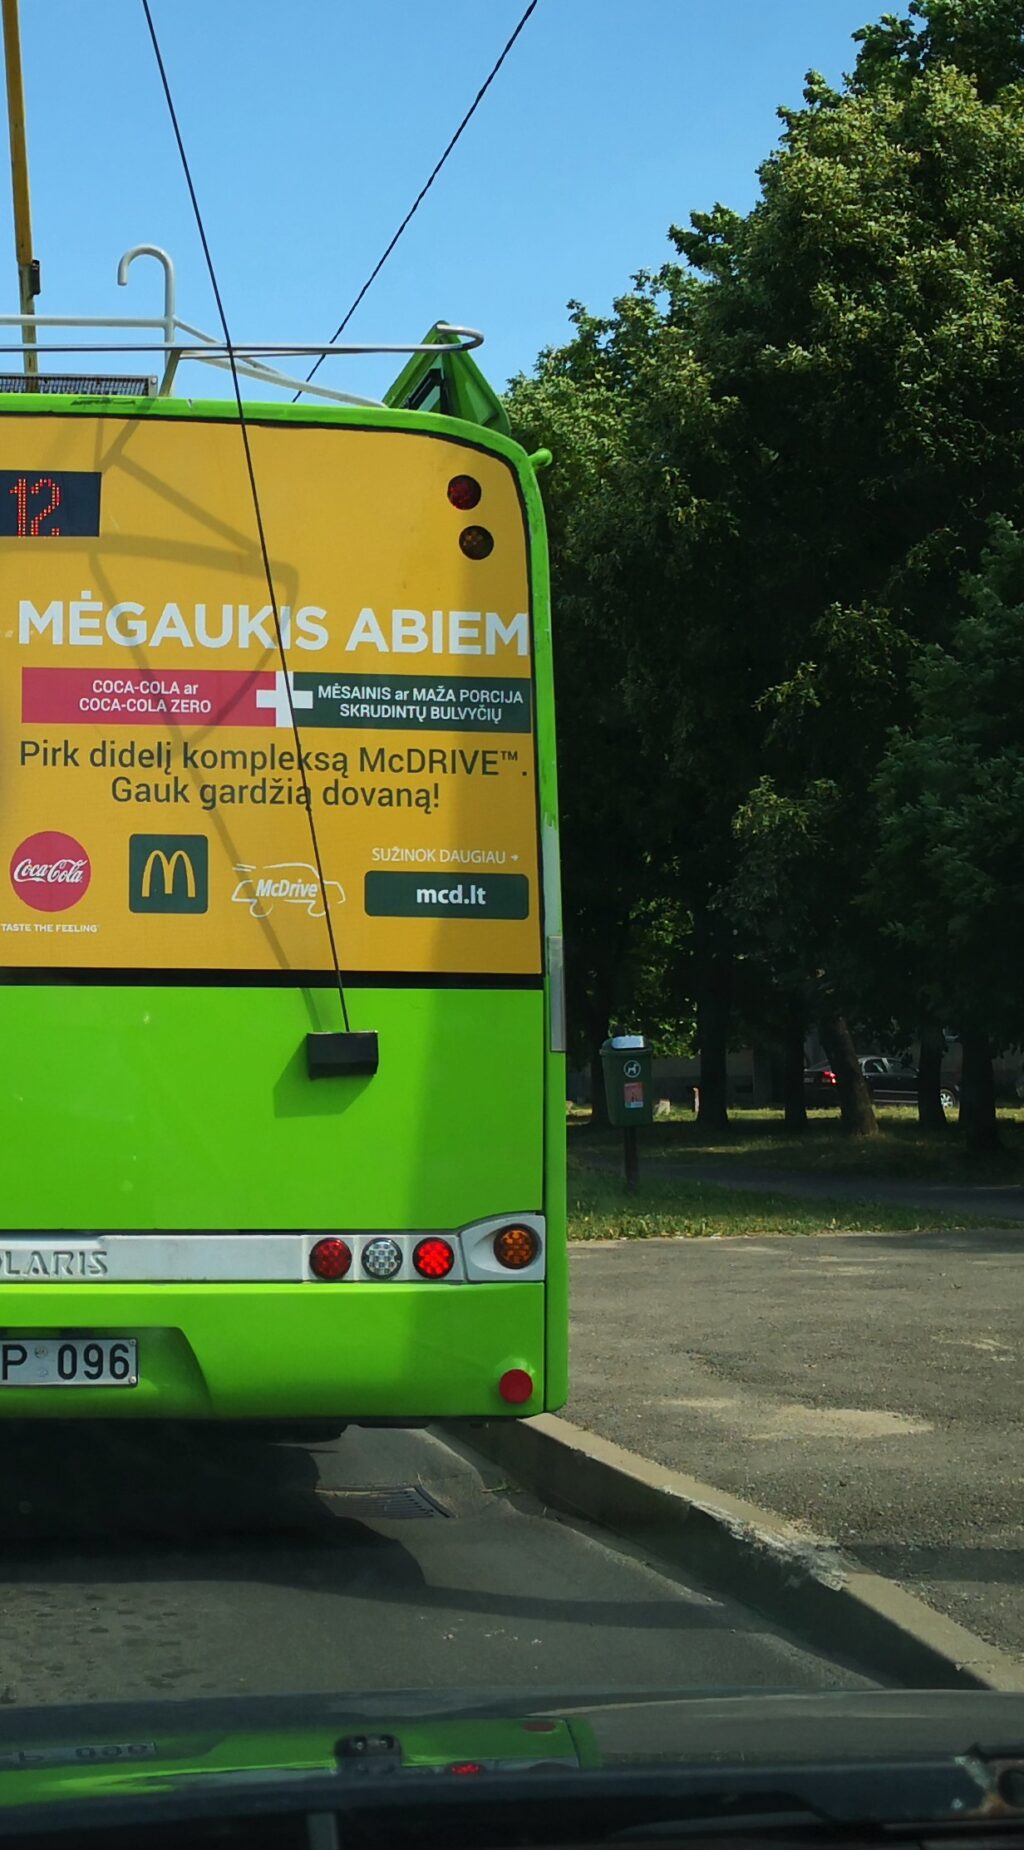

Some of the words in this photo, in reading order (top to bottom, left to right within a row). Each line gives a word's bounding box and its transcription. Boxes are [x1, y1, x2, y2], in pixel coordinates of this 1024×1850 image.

[18, 590, 329, 652] MĖGAUKIS
[345, 606, 529, 656] ABIEM
[92, 680, 180, 696] COCA-COLA
[184, 683, 199, 696] ar
[318, 683, 391, 701] MĖSAINIS
[394, 690, 409, 701] ar
[413, 685, 456, 702] MAŽA
[459, 689, 524, 704] PORCIJA
[79, 698, 167, 713] COCA-COLA
[170, 699, 212, 714] ZERO
[339, 704, 426, 722] SKRUDINTŲ
[430, 705, 502, 724] BULVYČIŲ
[19, 740, 80, 768] Pirk
[89, 741, 172, 775] didelį
[182, 742, 349, 779] kompleksą
[111, 776, 190, 805] Gauk
[200, 778, 312, 811] gardžią
[322, 780, 440, 815] dovaną!
[372, 846, 436, 863] SUŽINOK
[439, 850, 506, 864] DAUGIAU
[13, 858, 88, 883] Coca-Cola
[256, 879, 318, 898] McDrive
[416, 884, 487, 905] mcd.lt
[0, 923, 32, 932] TASTE
[34, 924, 54, 932] THE
[57, 1343, 130, 1381] 096
